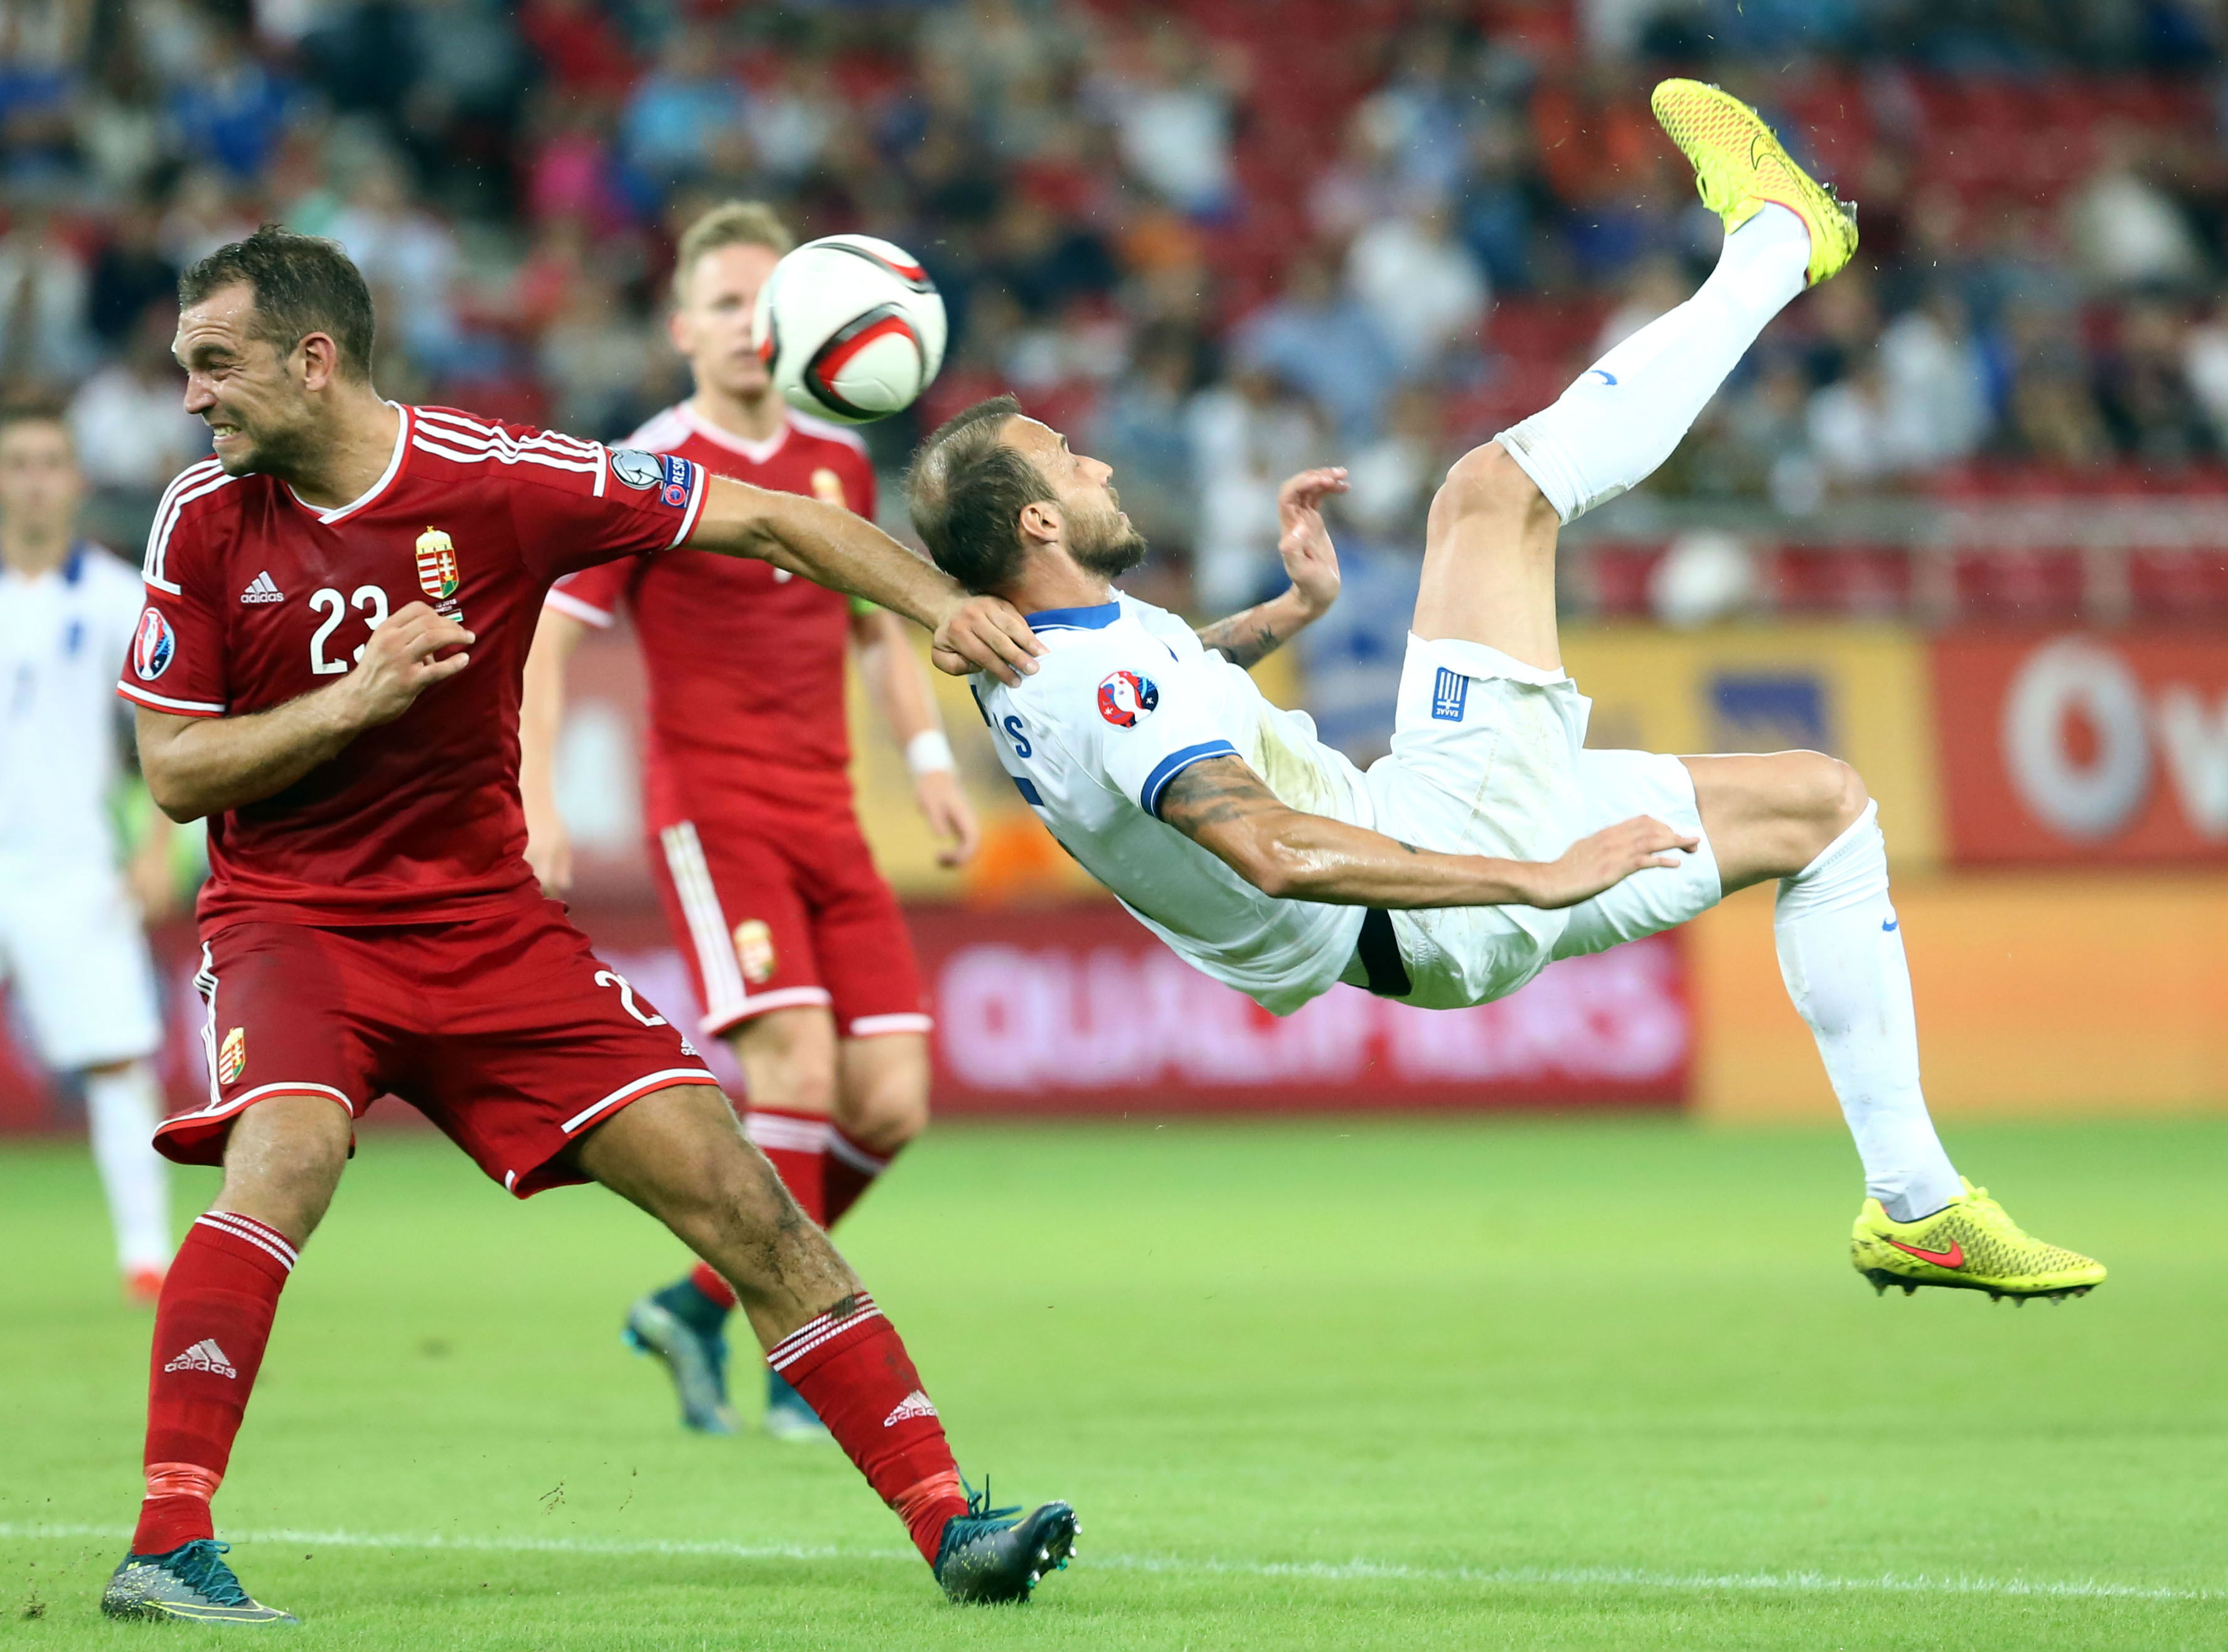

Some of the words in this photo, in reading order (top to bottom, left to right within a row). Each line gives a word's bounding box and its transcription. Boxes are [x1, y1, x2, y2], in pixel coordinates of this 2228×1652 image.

[240, 591, 284, 604] adidas
[308, 584, 389, 675] 23
[594, 970, 668, 1027] 2
[164, 1358, 237, 1380] adidas
[883, 1407, 939, 1427] adida
